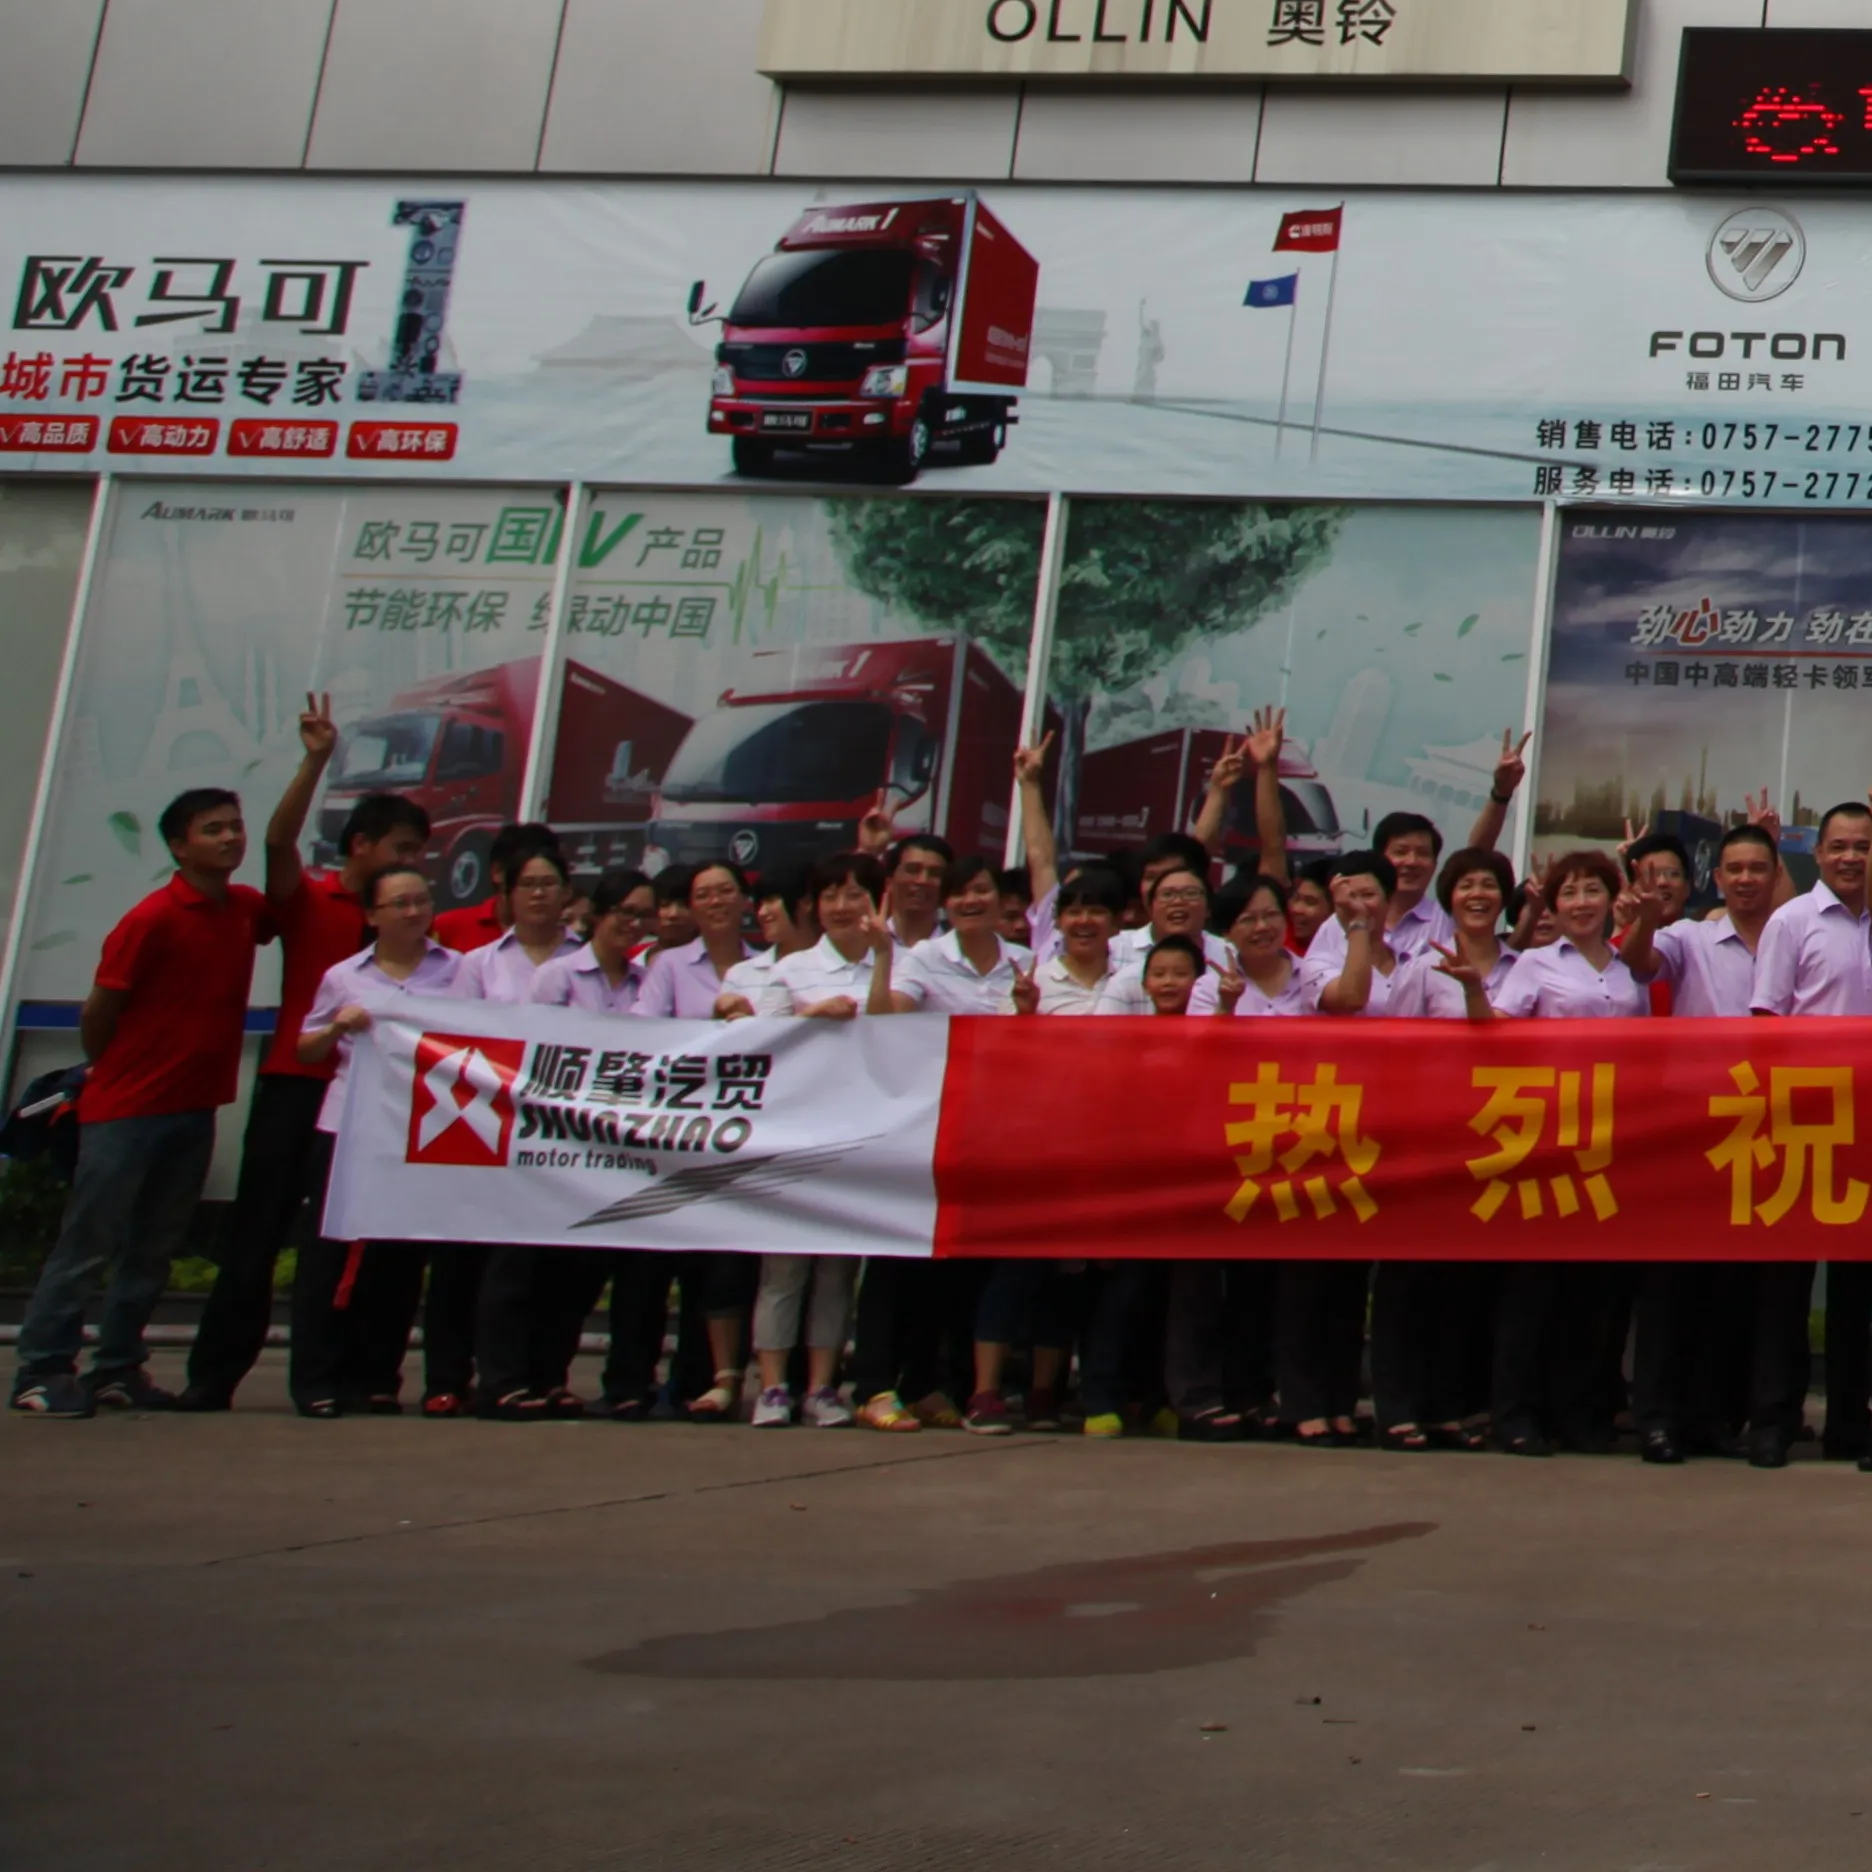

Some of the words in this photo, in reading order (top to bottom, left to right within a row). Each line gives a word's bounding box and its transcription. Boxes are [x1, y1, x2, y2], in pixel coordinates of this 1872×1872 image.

[12, 255, 371, 336] 欧马可
[1649, 331, 1847, 361] FOTON
[0, 352, 349, 406] 城市货运专家
[1686, 371, 1805, 392] 福田汽车
[17, 418, 92, 446] 高品质
[138, 420, 212, 450] 高动力
[258, 424, 331, 453] 高舒适
[376, 427, 449, 455] 高环保
[343, 590, 511, 634] 节能环保
[519, 1042, 773, 1111] 顺肇汽贸
[516, 1149, 582, 1169] motor
[584, 1151, 658, 1176] trading
